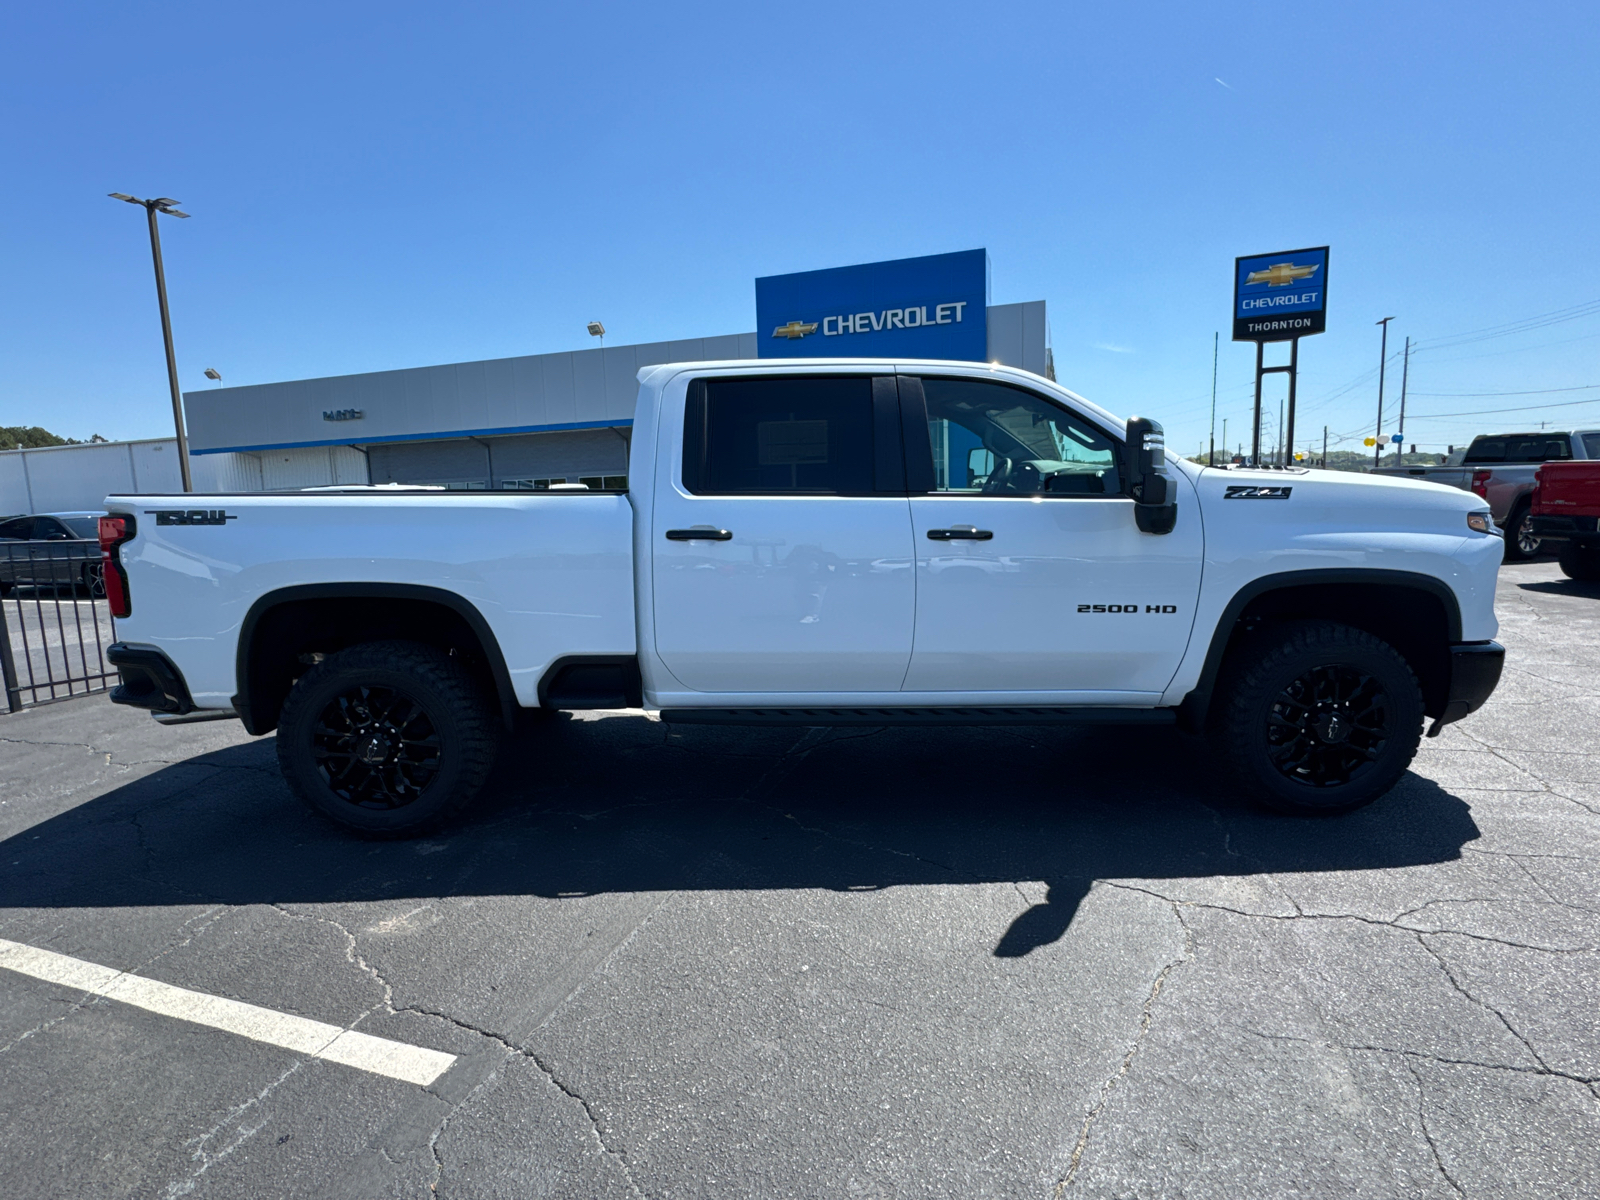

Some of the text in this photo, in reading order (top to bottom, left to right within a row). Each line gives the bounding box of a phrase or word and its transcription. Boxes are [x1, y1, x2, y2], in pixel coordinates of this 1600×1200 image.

[1242, 292, 1318, 310] CHEVROLET
[823, 301, 967, 336] CHEVROLET
[1248, 318, 1311, 332] THORNTON
[1077, 604, 1177, 614] 2500 HD
